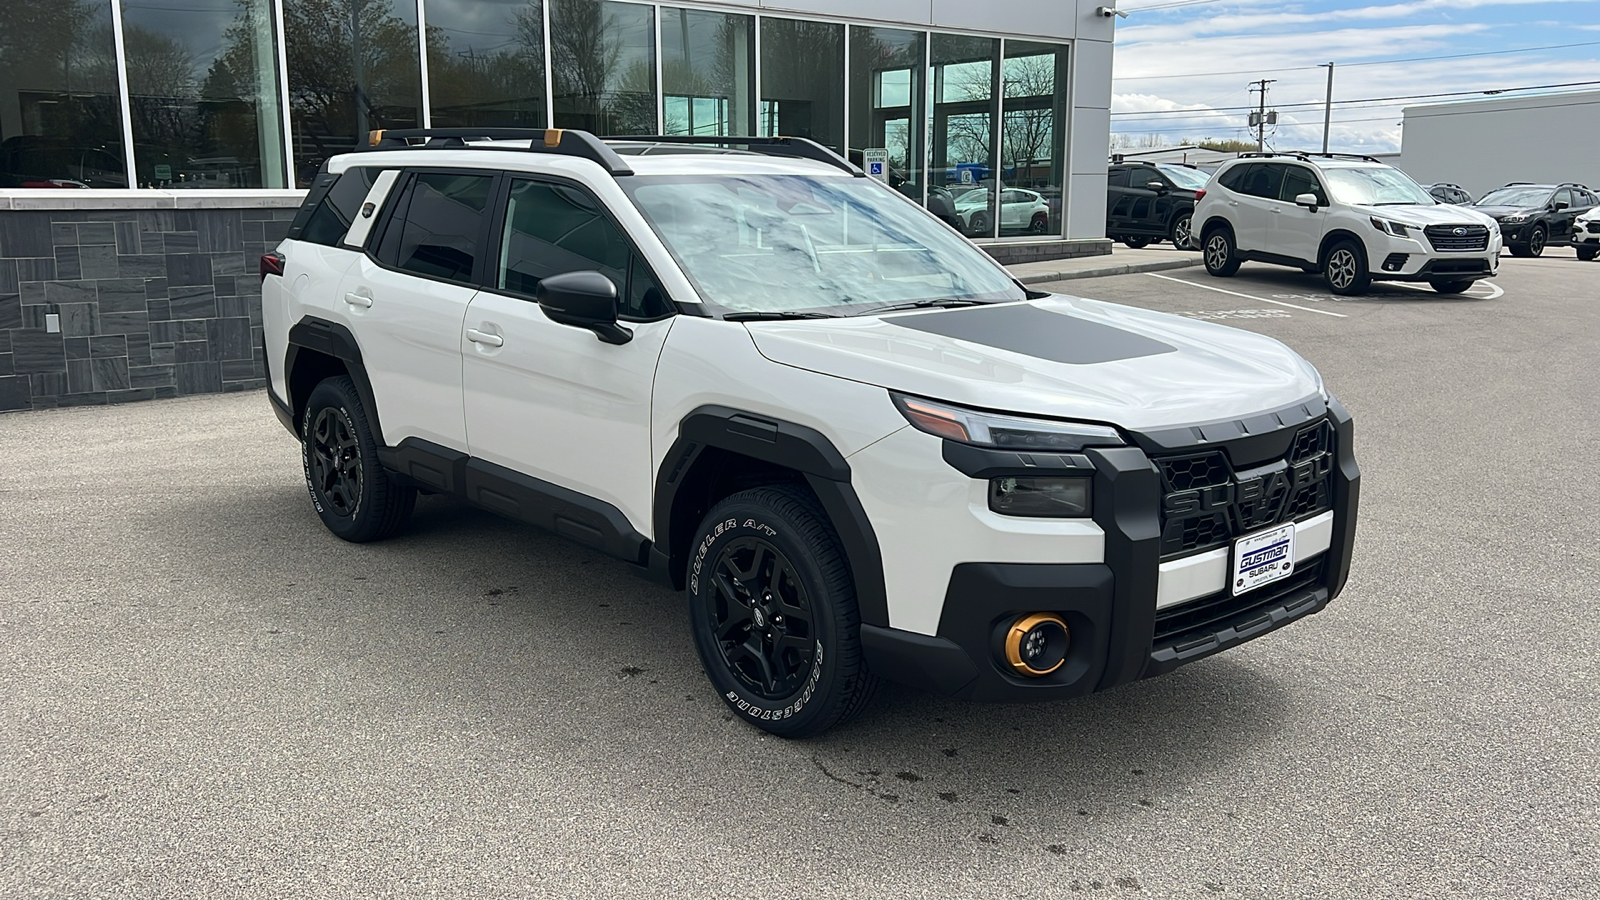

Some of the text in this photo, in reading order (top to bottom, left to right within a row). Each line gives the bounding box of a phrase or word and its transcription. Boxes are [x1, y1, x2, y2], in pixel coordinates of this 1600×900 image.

[1163, 452, 1333, 518] SUBARU
[690, 518, 777, 596] DUELER A/T
[1248, 563, 1279, 578] SUBARU
[725, 639, 825, 722] BRIDGESTONE
